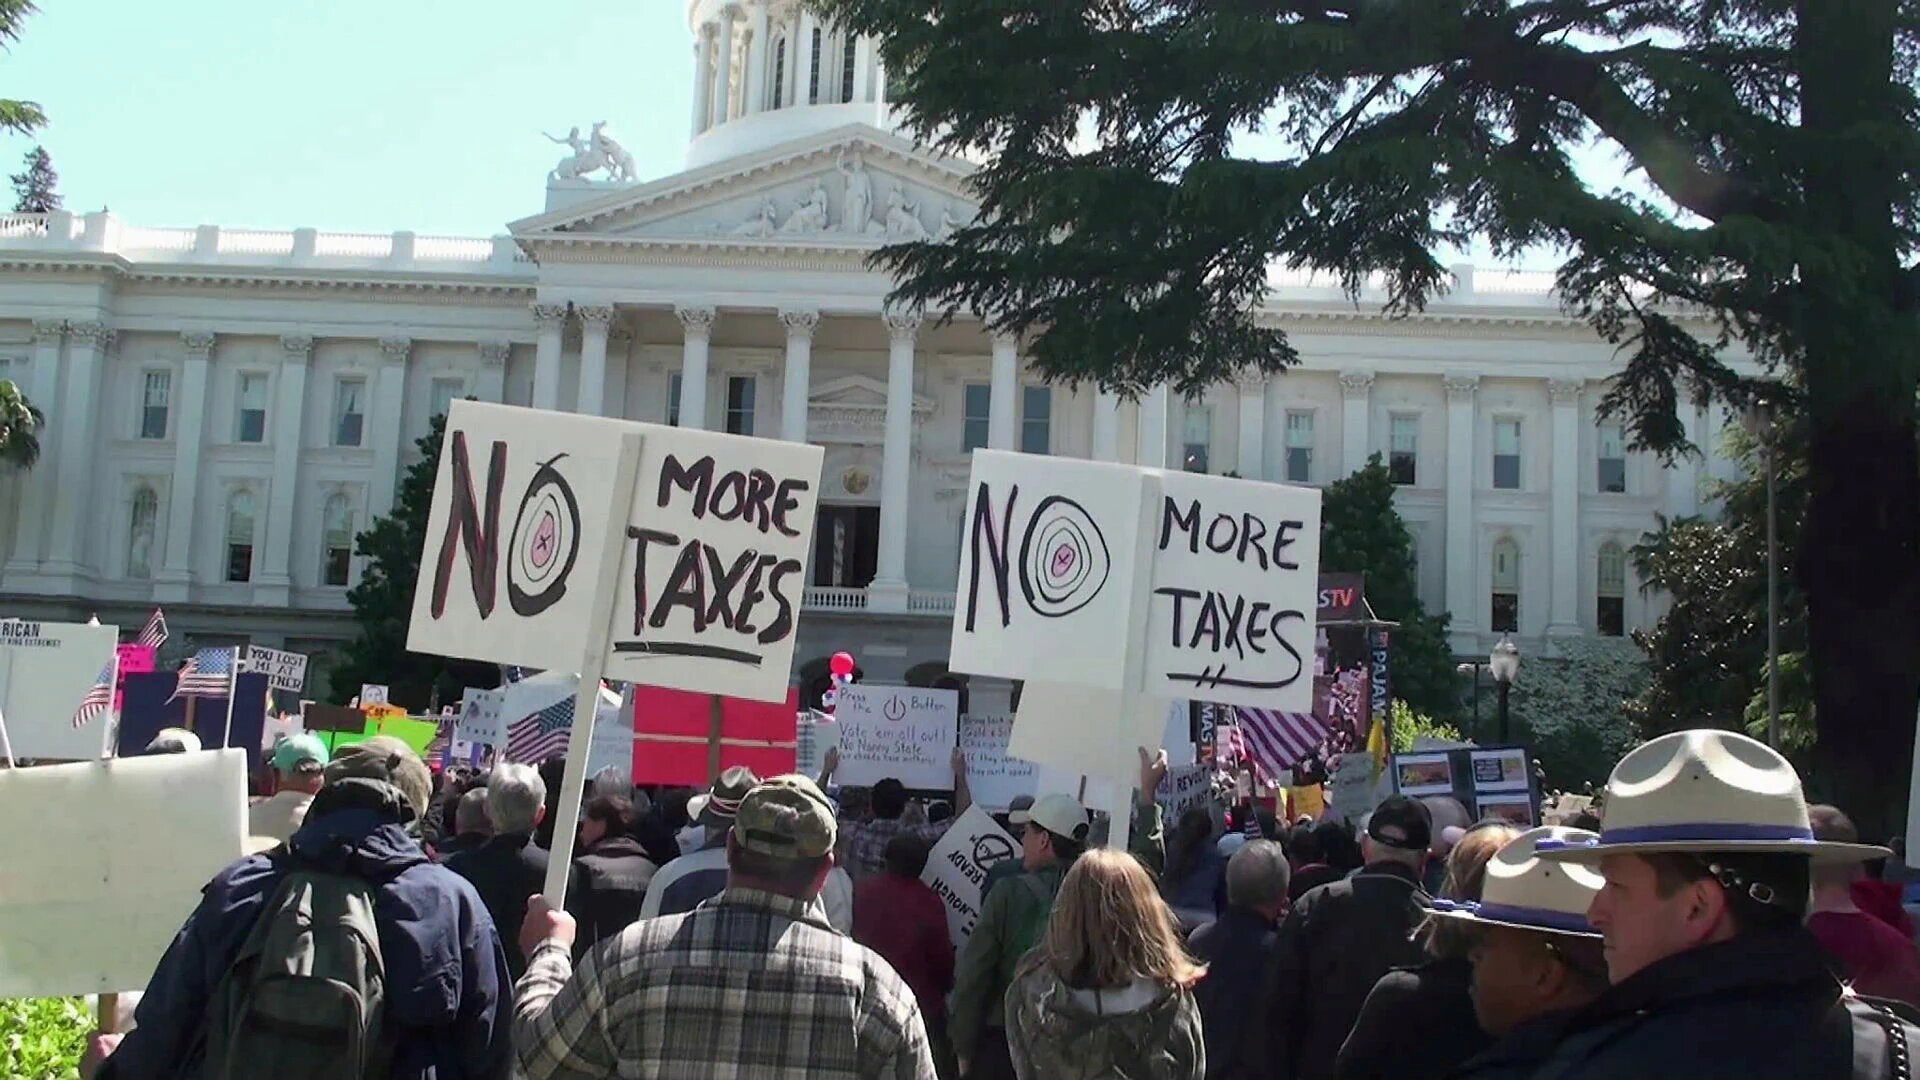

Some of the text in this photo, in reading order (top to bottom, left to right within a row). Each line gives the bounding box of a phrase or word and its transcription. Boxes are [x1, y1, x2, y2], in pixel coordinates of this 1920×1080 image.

[431, 430, 581, 621] NO
[657, 453, 809, 536] MORE
[965, 481, 1111, 633] NO
[1159, 496, 1304, 571] MORE
[628, 525, 802, 645] TAXES
[1317, 588, 1354, 608] STV
[0, 622, 41, 637] RICAN
[250, 648, 303, 667] YOU LOST
[1154, 586, 1306, 680] TAXES
[277, 665, 296, 676] AT
[1371, 650, 1388, 715] PAJAM
[1200, 702, 1215, 764] MASTV
[947, 850, 984, 887] READY
